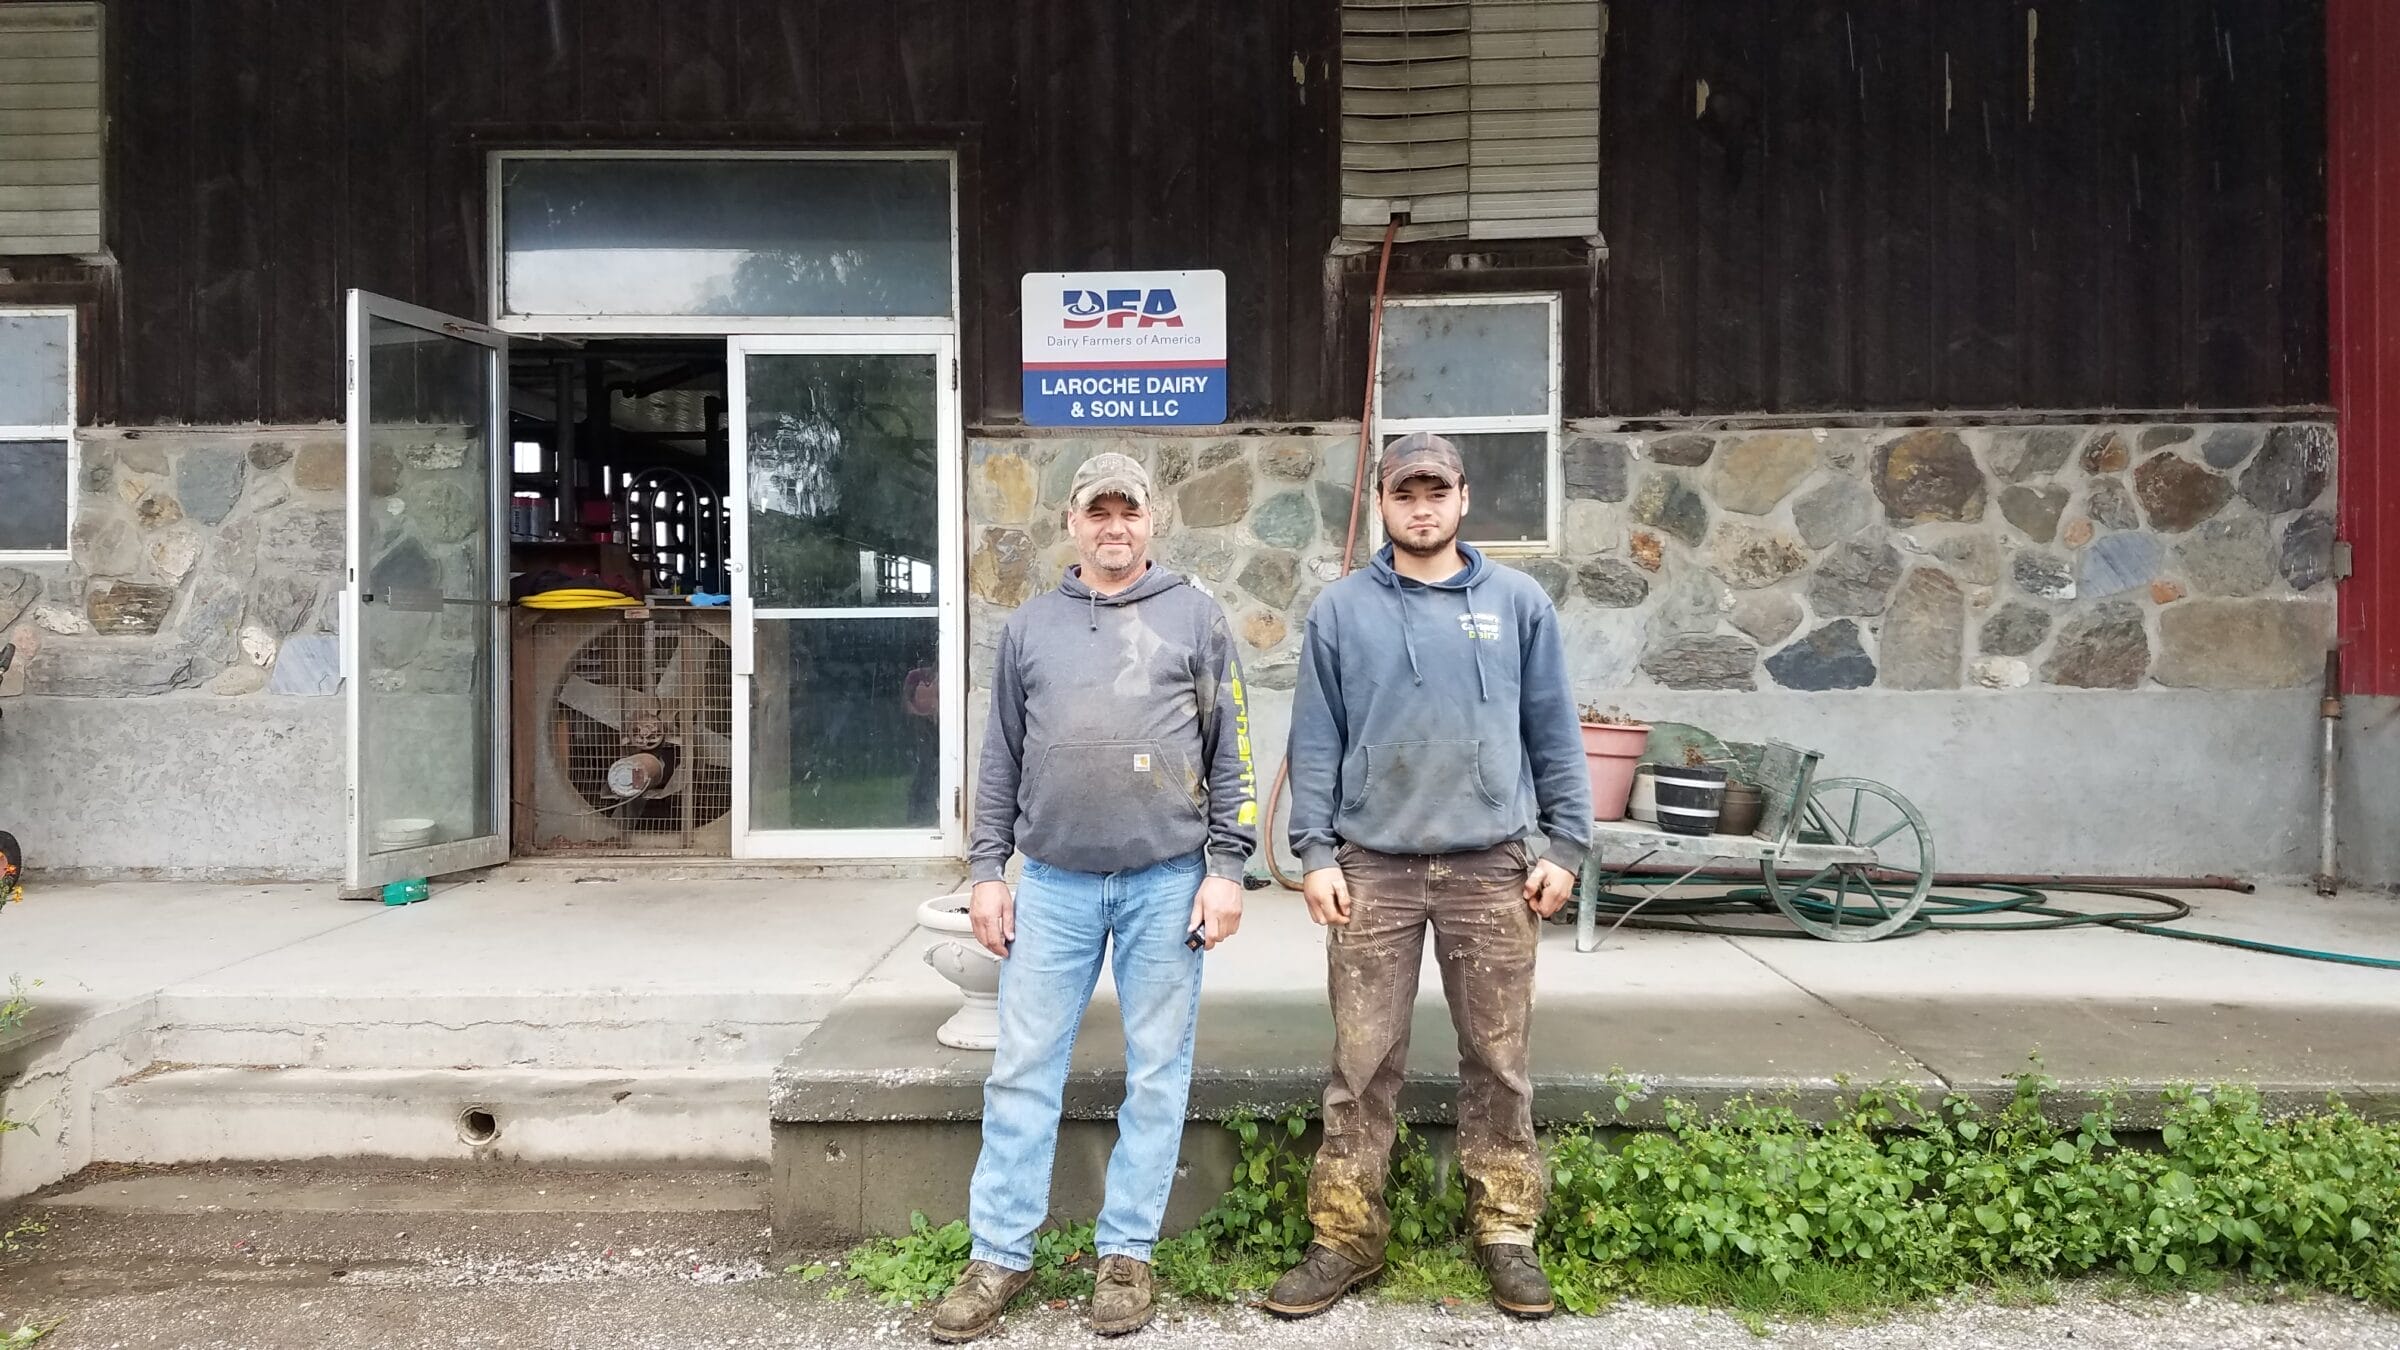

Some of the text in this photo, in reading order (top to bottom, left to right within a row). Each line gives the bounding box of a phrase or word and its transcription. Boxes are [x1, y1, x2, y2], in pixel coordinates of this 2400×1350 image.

[1063, 288, 1184, 329] DFA
[1047, 334, 1201, 348] Dairy Farmers of America
[1041, 376, 1208, 395] LAROCHE DAIRY
[1070, 400, 1179, 418] & SON LLC
